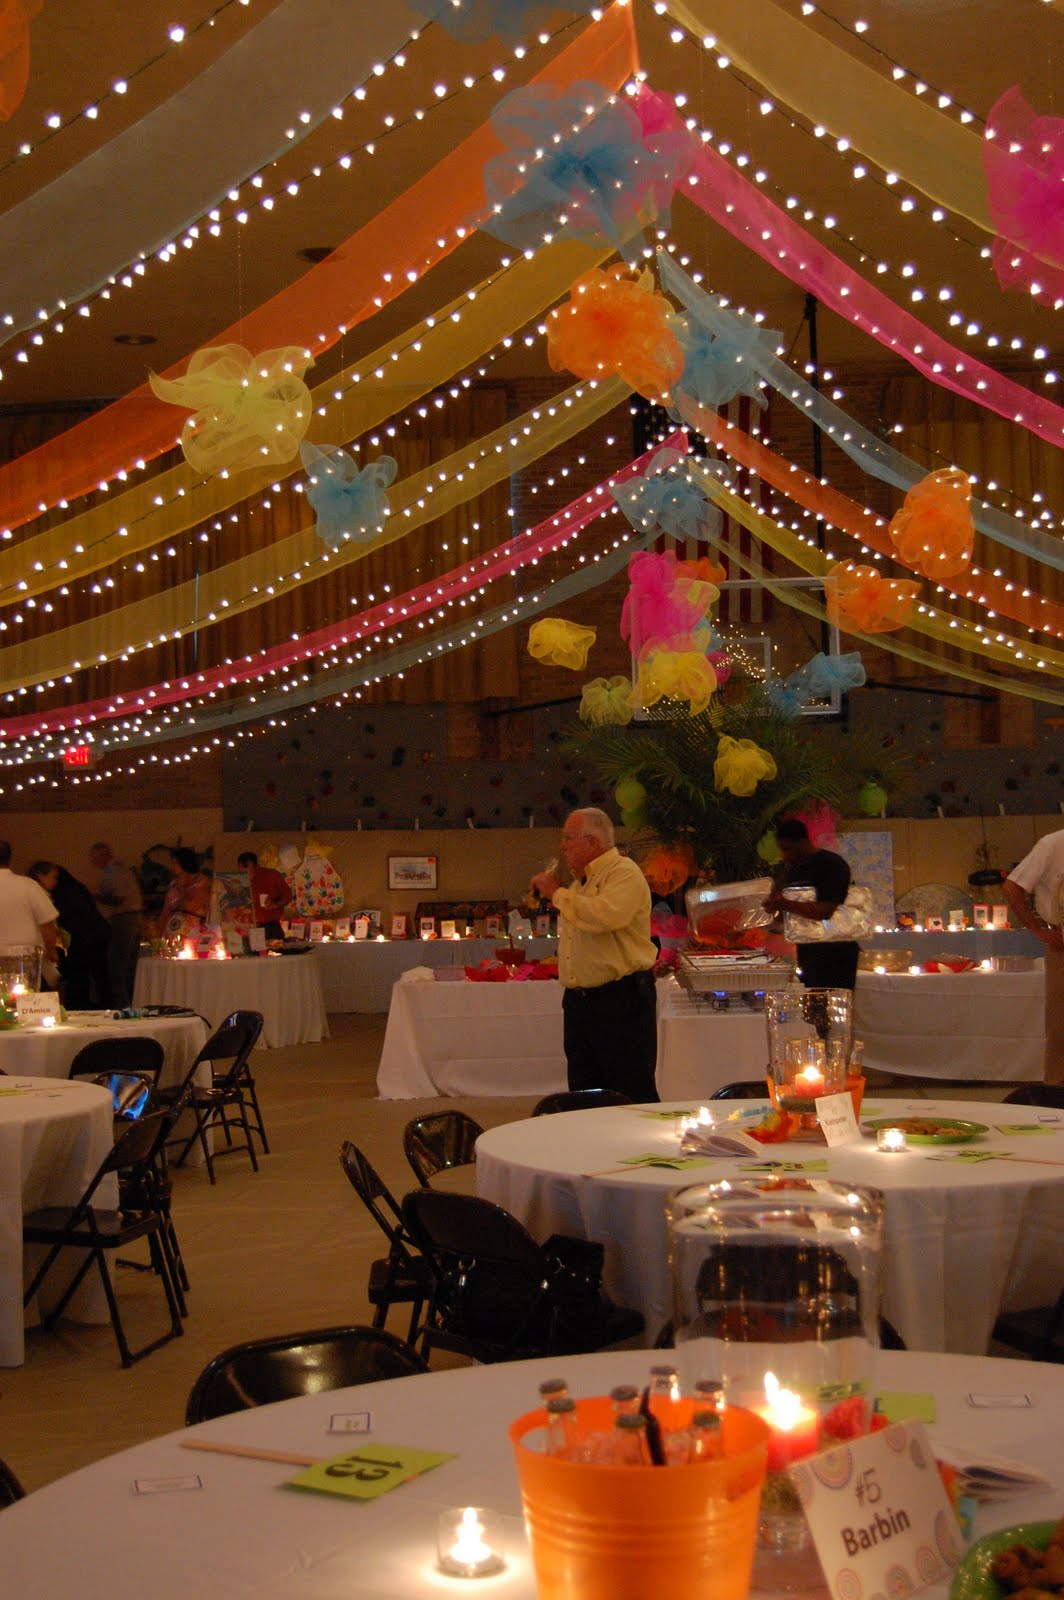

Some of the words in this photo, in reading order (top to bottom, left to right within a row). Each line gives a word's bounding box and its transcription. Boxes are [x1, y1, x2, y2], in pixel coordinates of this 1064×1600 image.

[67, 746, 90, 764] EXIT
[325, 1456, 403, 1481] 13
[855, 1467, 881, 1507] #5
[841, 1507, 911, 1557] Barbin
